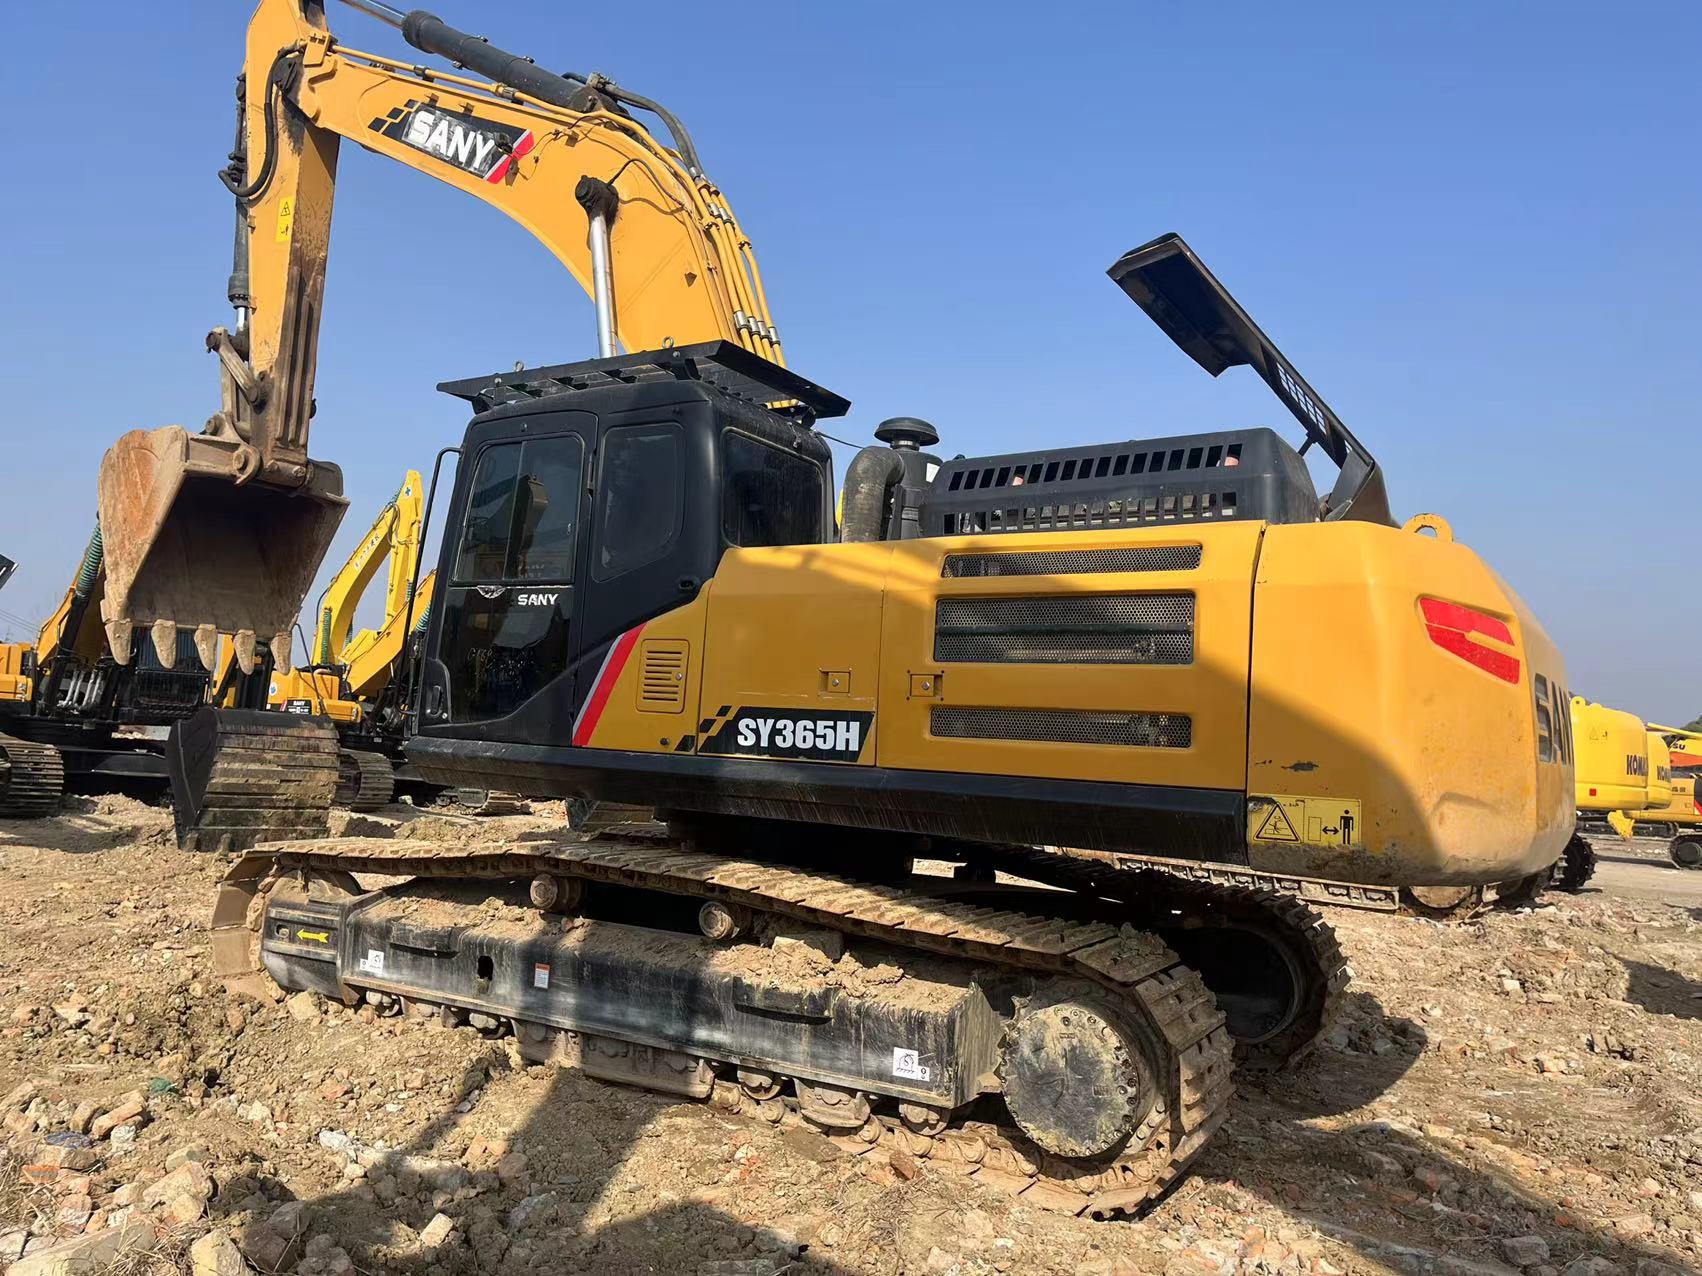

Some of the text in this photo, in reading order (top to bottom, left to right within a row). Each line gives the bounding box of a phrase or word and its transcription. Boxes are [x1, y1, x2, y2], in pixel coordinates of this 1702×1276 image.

[408, 111, 496, 170] SANY
[518, 593, 559, 606] SANY
[737, 718, 860, 751] SY365H
